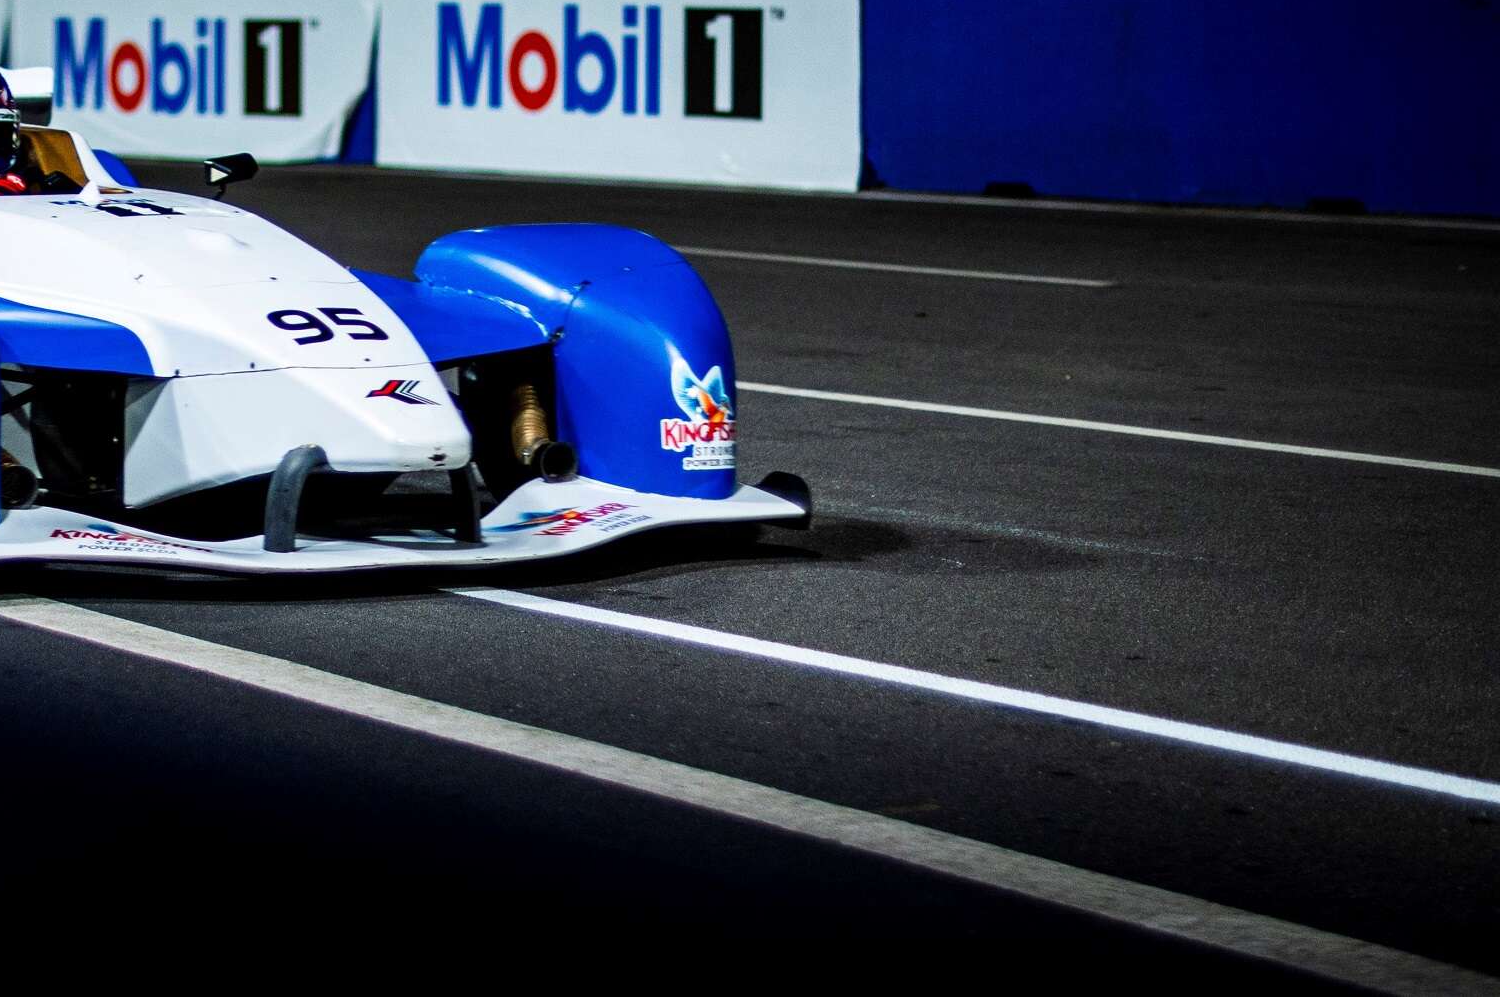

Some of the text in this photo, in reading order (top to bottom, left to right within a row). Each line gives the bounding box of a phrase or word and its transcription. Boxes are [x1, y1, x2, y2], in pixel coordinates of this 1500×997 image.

[54, 17, 226, 115] Mobil
[437, 2, 661, 116] Mobil
[266, 307, 389, 345] 95
